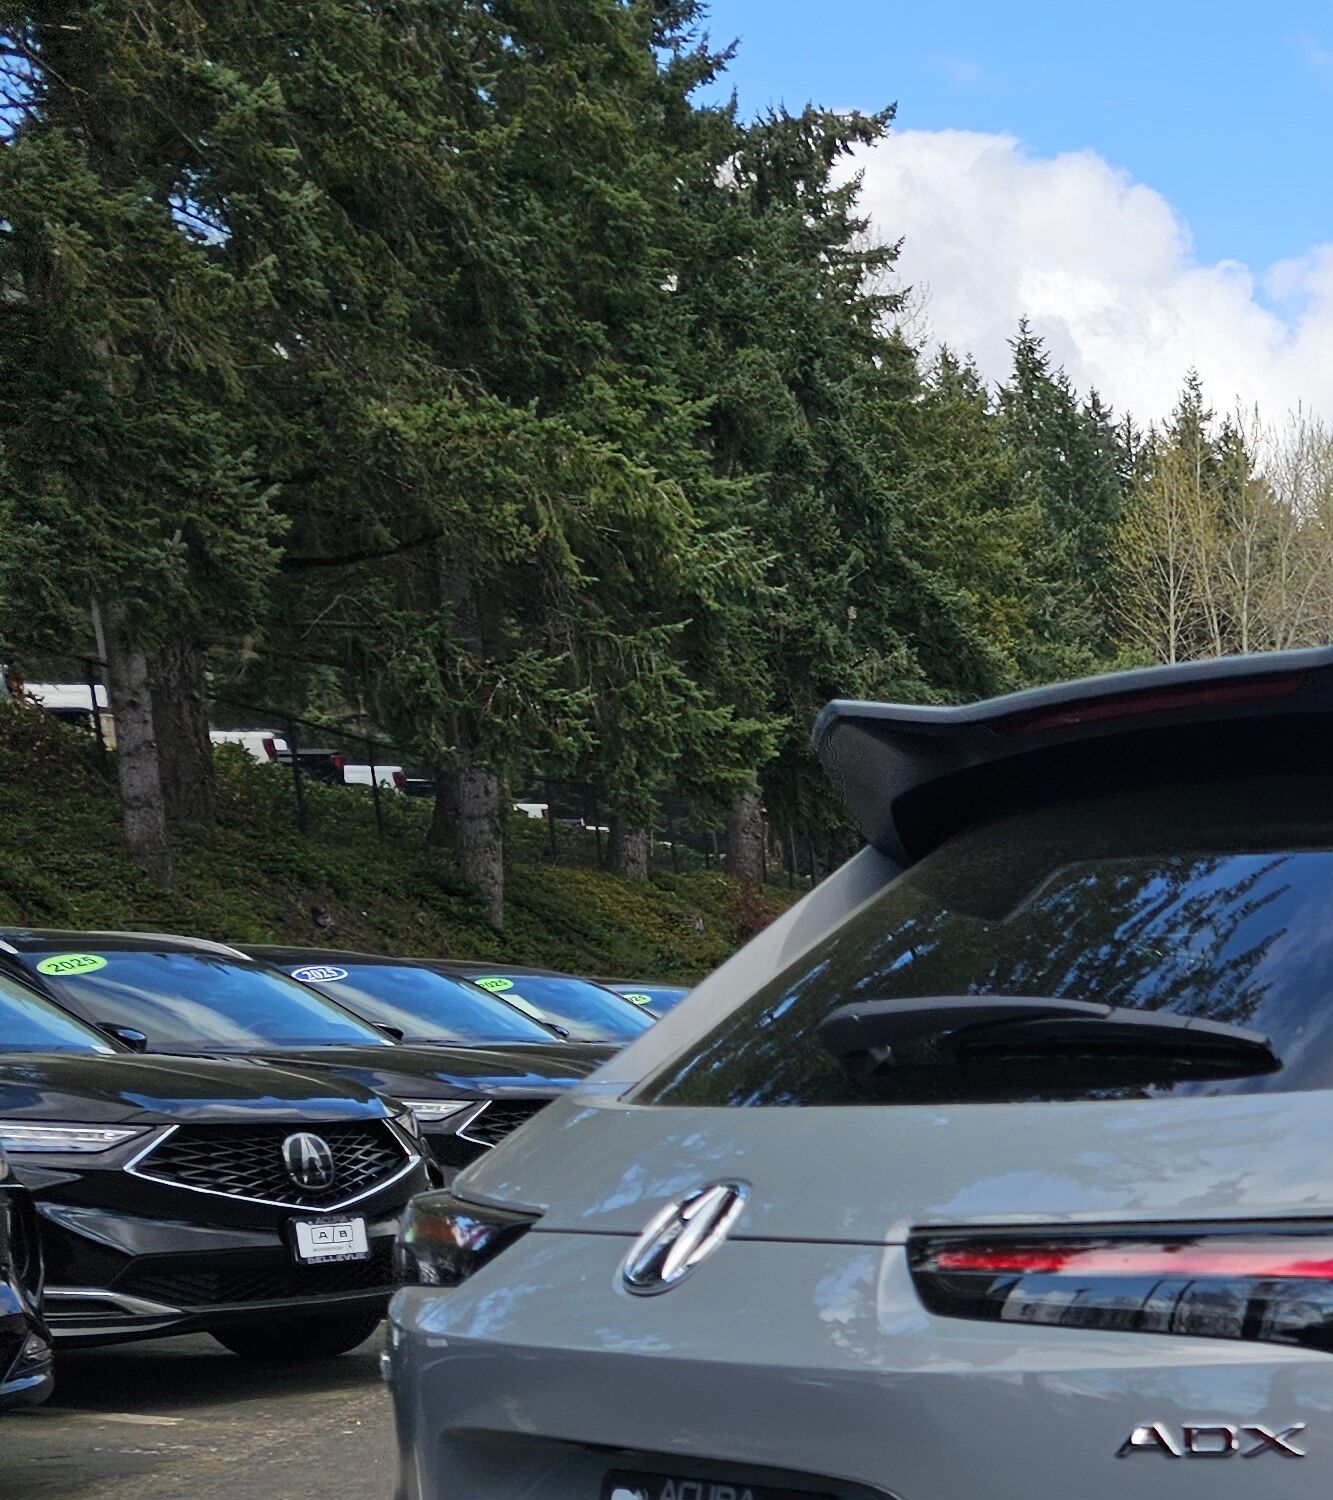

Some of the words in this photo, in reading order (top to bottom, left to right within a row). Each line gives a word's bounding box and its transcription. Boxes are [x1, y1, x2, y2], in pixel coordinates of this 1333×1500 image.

[47, 956, 98, 973] 2025
[301, 967, 339, 980] 2025
[1114, 1421, 1307, 1459] ADX
